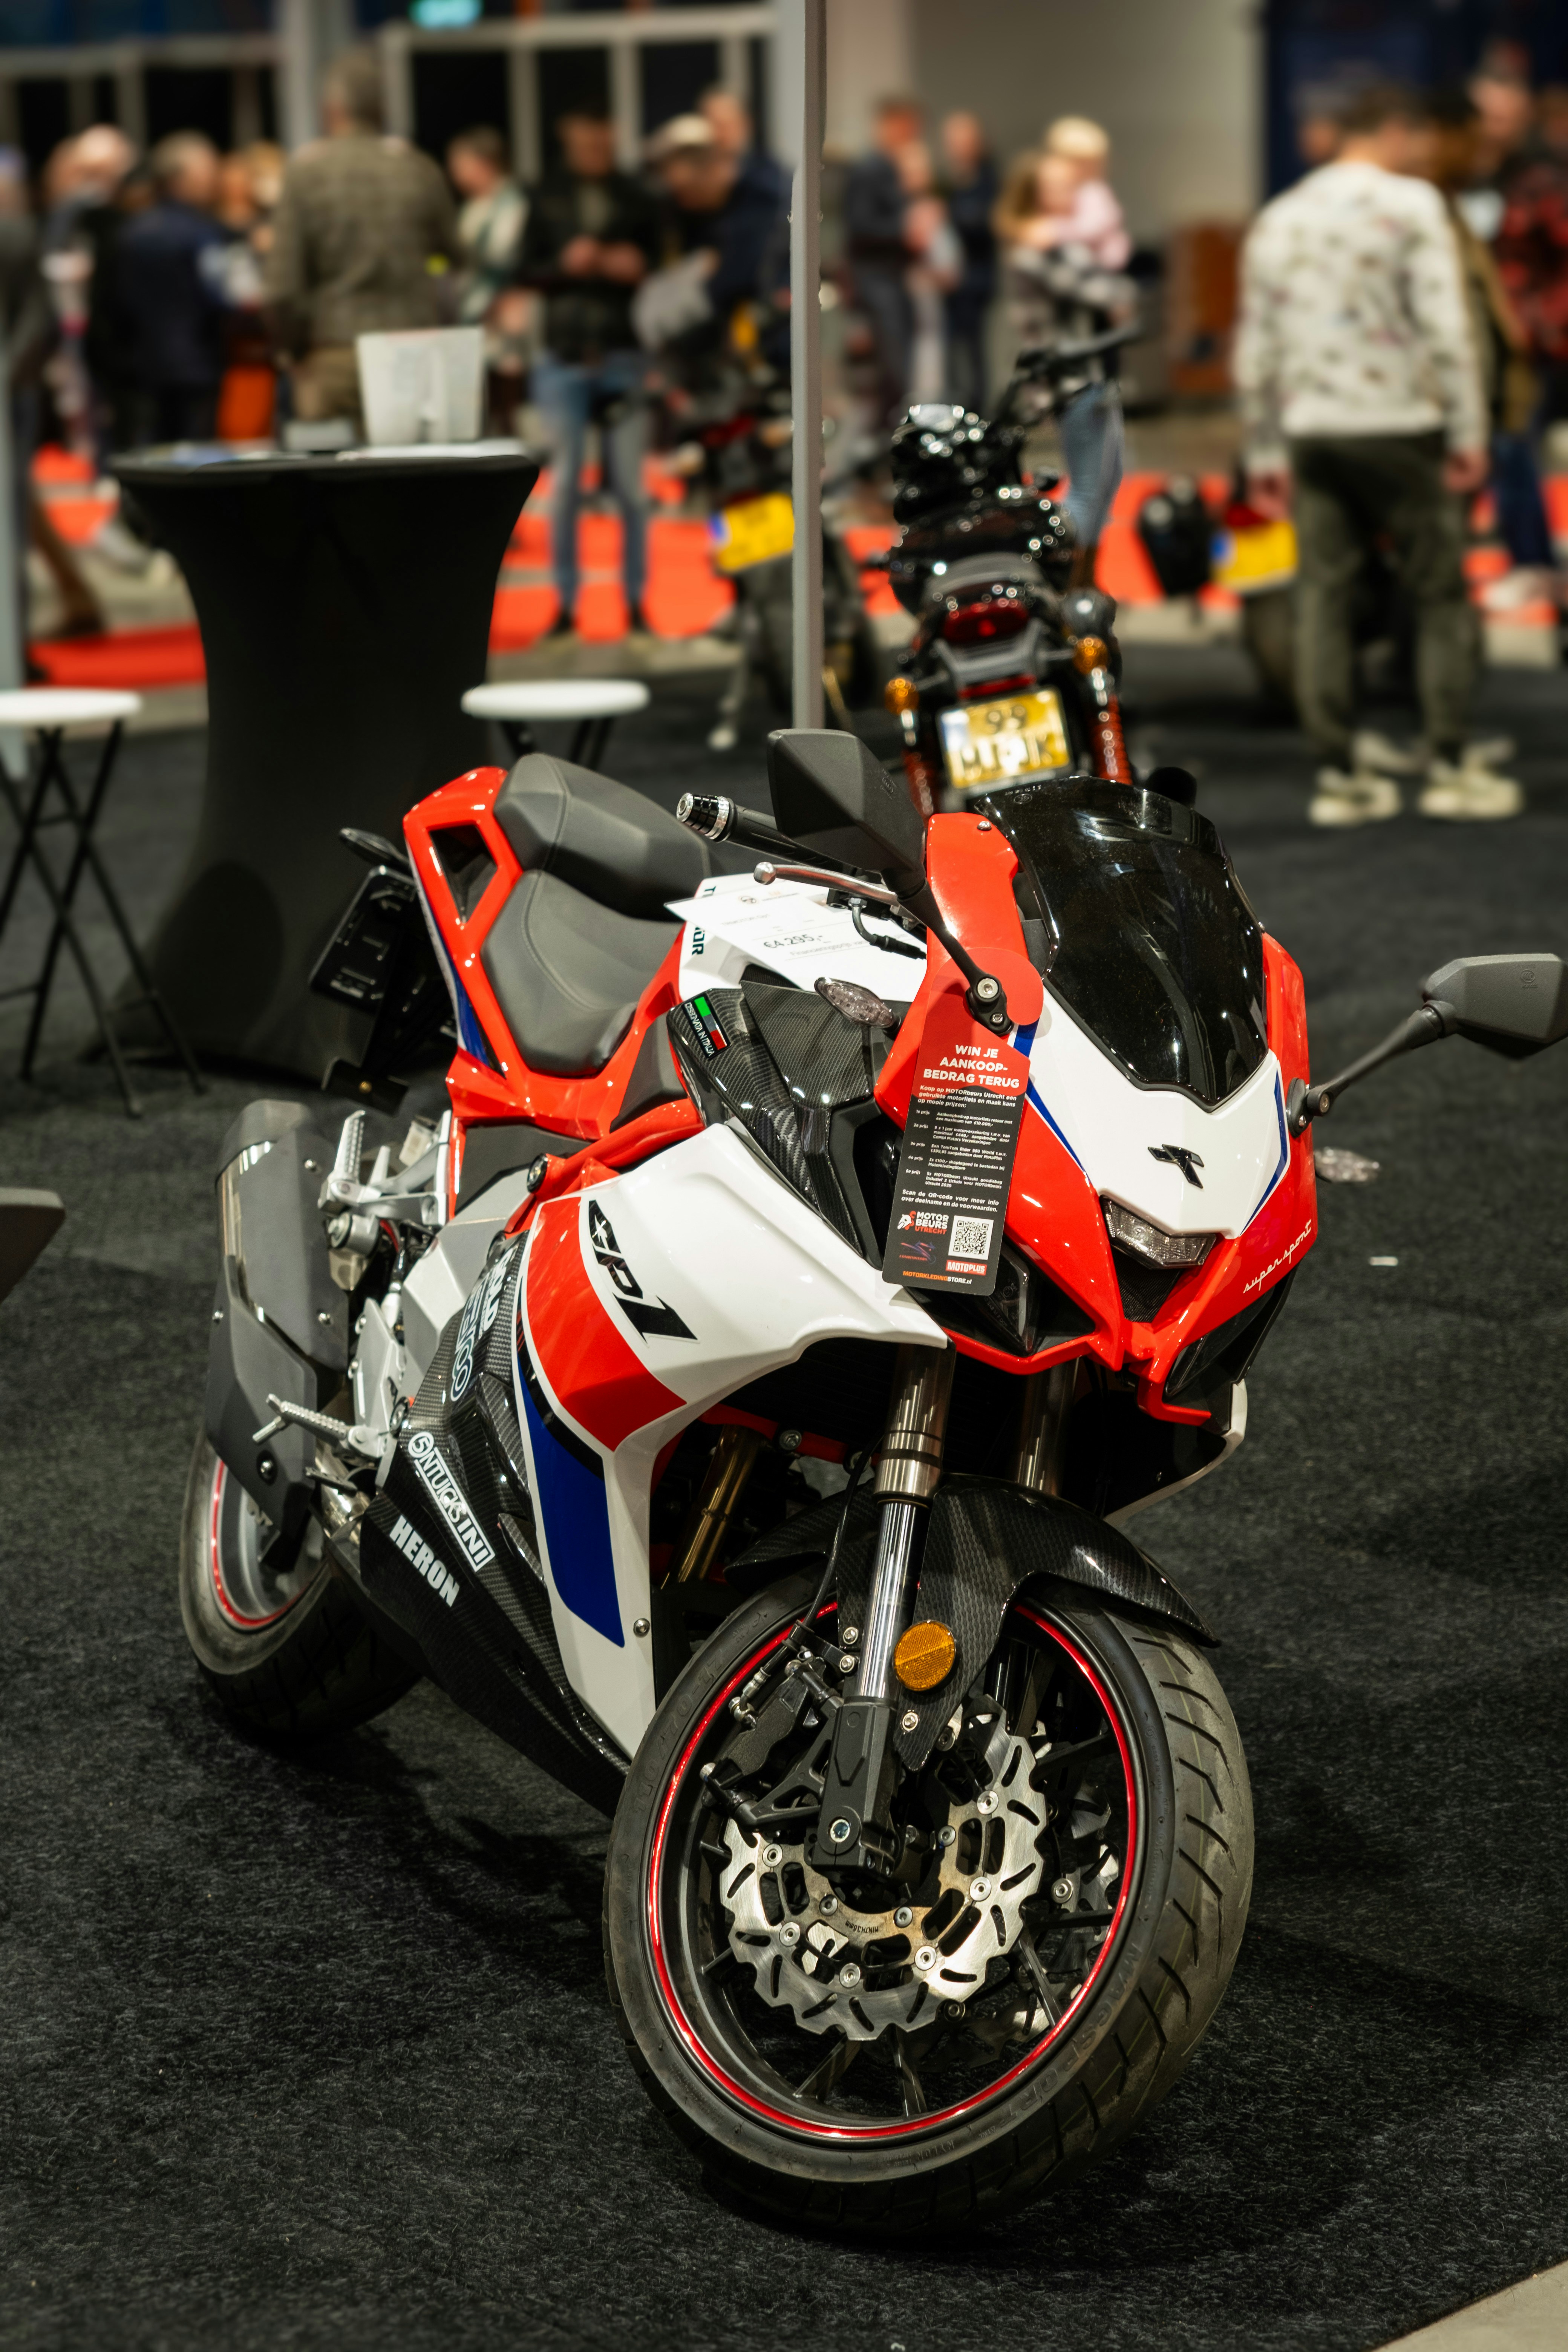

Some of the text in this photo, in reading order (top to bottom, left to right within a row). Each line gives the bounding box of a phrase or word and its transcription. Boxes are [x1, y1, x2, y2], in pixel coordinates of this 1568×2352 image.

[955, 1045, 999, 1058] WIN JE
[939, 1058, 1008, 1072] AANKOOP-
[923, 1069, 1020, 1088] BEDRAG TERUG
[945, 1088, 983, 1097] MOTORbeurs
[959, 1204, 998, 1212] voorwaarden.
[916, 1211, 949, 1223] MOTOR
[914, 1226, 947, 1234] UTRECHT
[915, 1218, 948, 1230] BEURS
[946, 1261, 986, 1273] MOTOPLUS
[389, 1514, 460, 1608] HERON
[998, 1941, 1143, 2130] MAGSPORT
